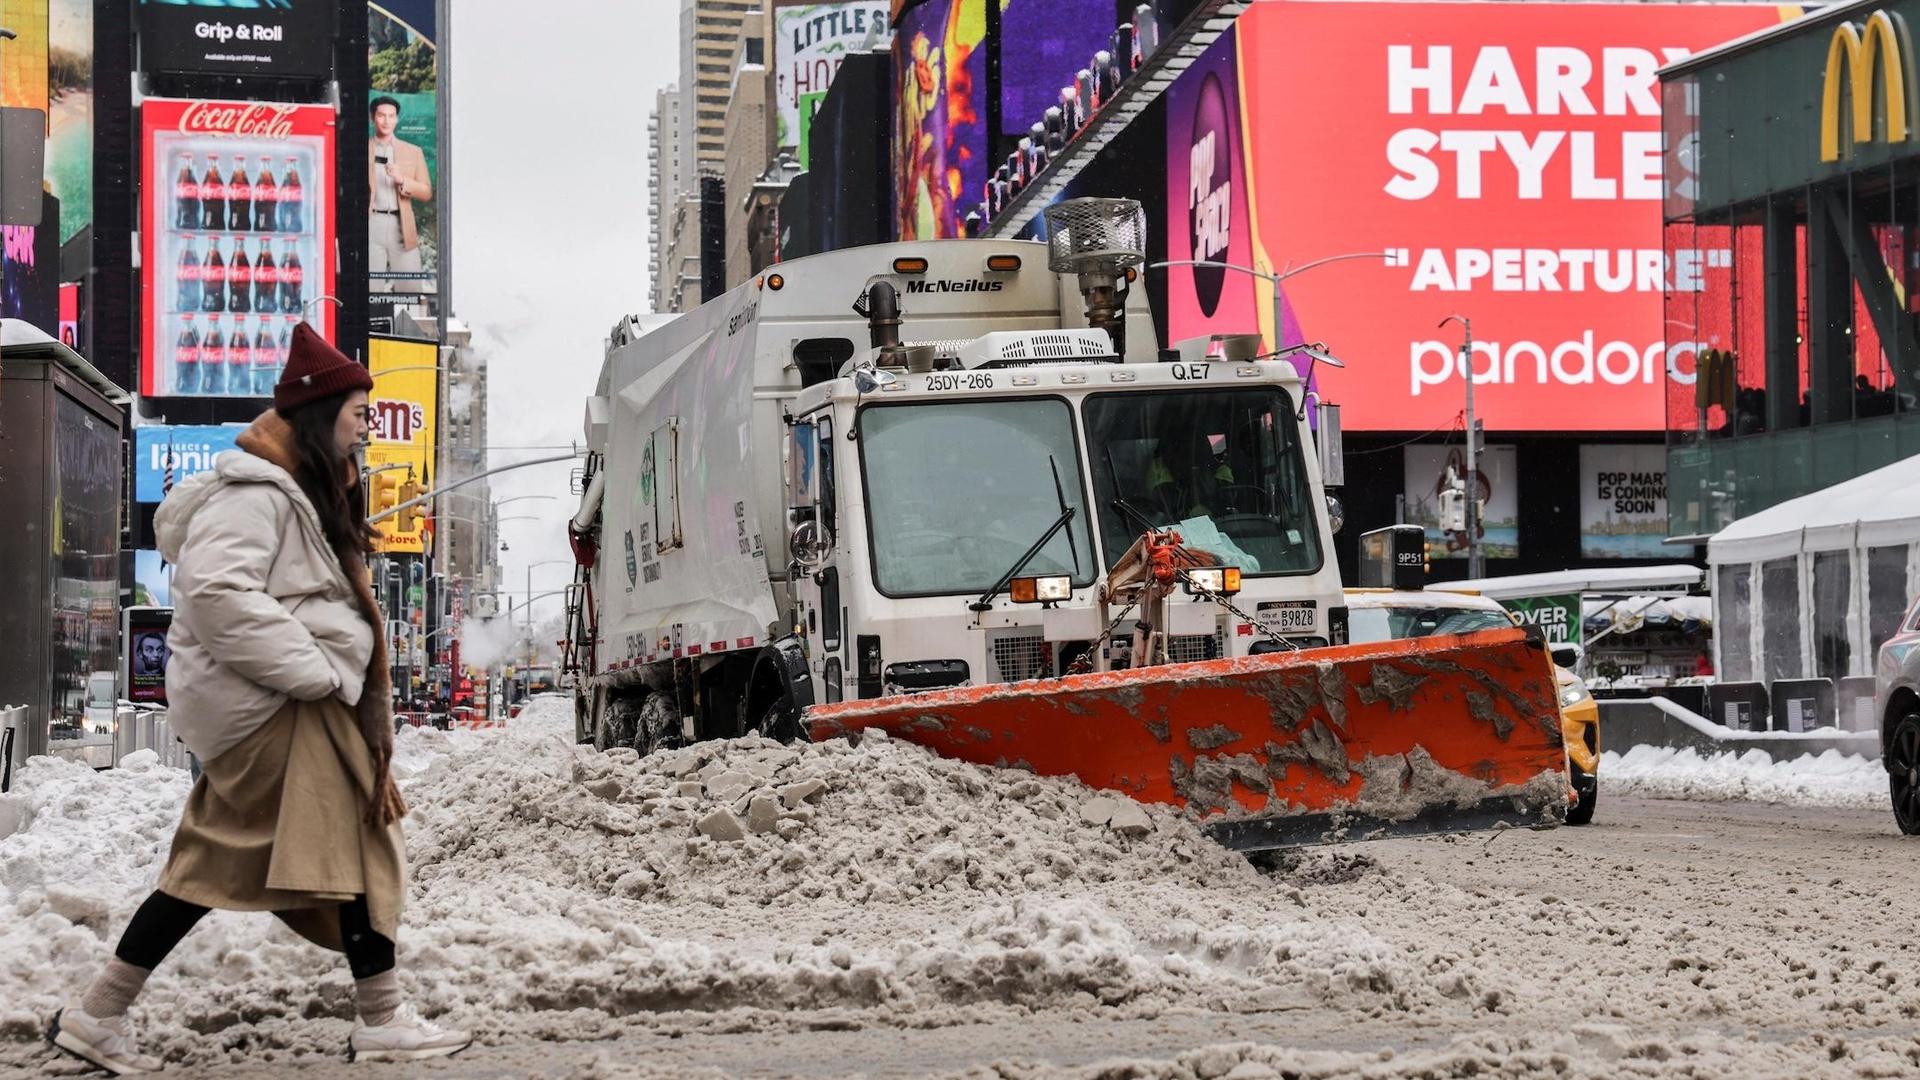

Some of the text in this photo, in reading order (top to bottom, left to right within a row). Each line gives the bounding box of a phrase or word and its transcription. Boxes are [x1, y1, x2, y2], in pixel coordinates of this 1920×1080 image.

[195, 21, 282, 43] Grip & Roll
[794, 8, 866, 55] LITTLE
[1384, 248, 1732, 293] "APERTURE"
[906, 279, 1004, 294] McNeilus
[1172, 363, 1210, 380] Q.E7
[1410, 330, 1708, 396] pandora
[926, 374, 993, 391] 25DY-266
[1597, 472, 1627, 485] POP
[1598, 486, 1611, 499] IS
[1615, 501, 1655, 513] SOON
[1398, 552, 1422, 563] 9P51
